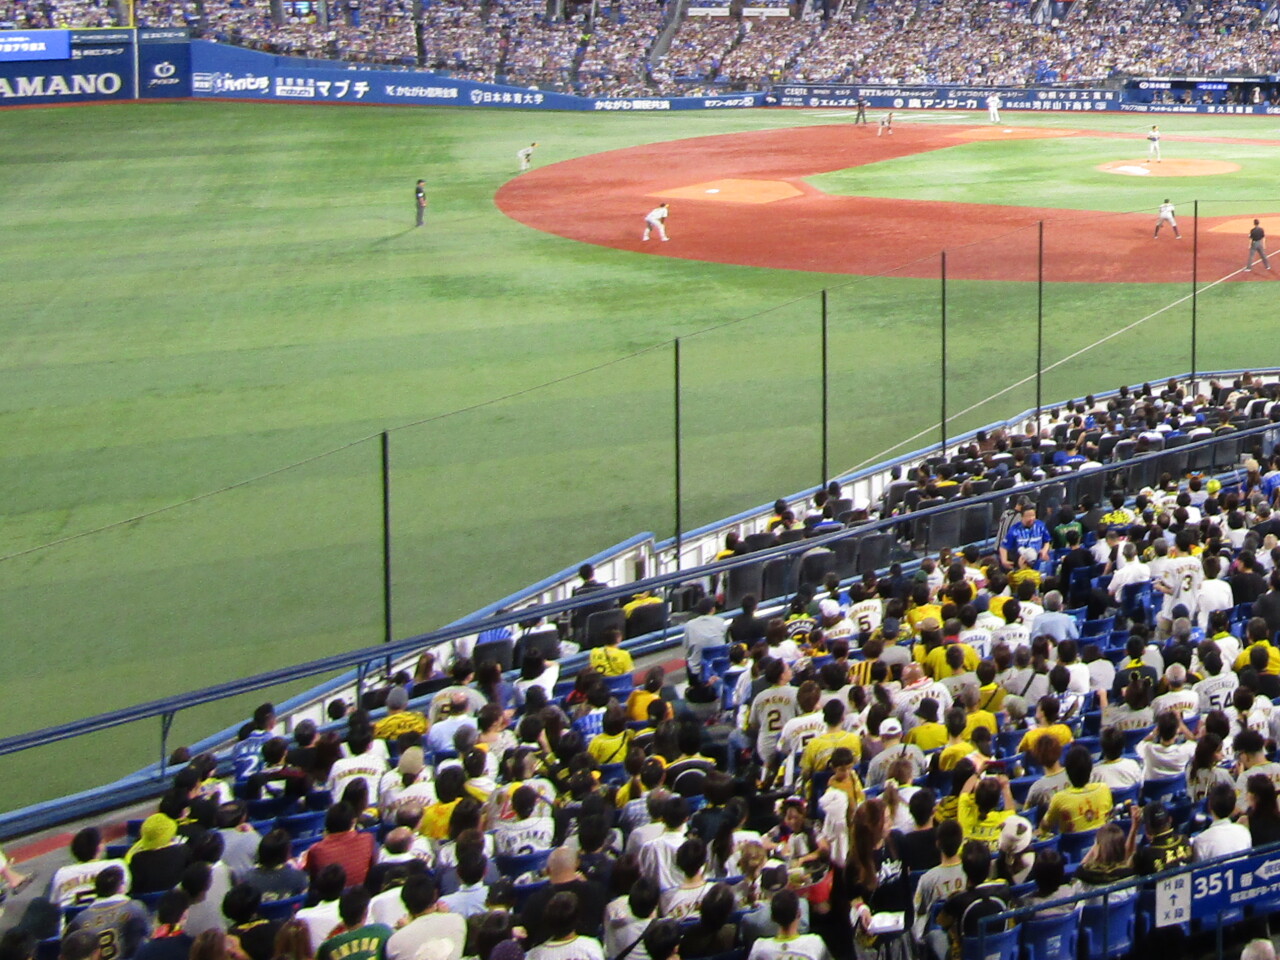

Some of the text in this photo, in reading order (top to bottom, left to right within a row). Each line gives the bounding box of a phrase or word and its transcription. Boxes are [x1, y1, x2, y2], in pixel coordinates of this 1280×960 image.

[316, 80, 370, 99] マブチ
[483, 93, 544, 105] 日本体育大学
[1182, 574, 1193, 592] 3
[857, 615, 871, 633] 5
[1210, 692, 1234, 710] 54
[767, 709, 782, 732] 2
[241, 754, 259, 778] 2
[1163, 877, 1185, 891] H段
[1193, 869, 1254, 899] 351 番
